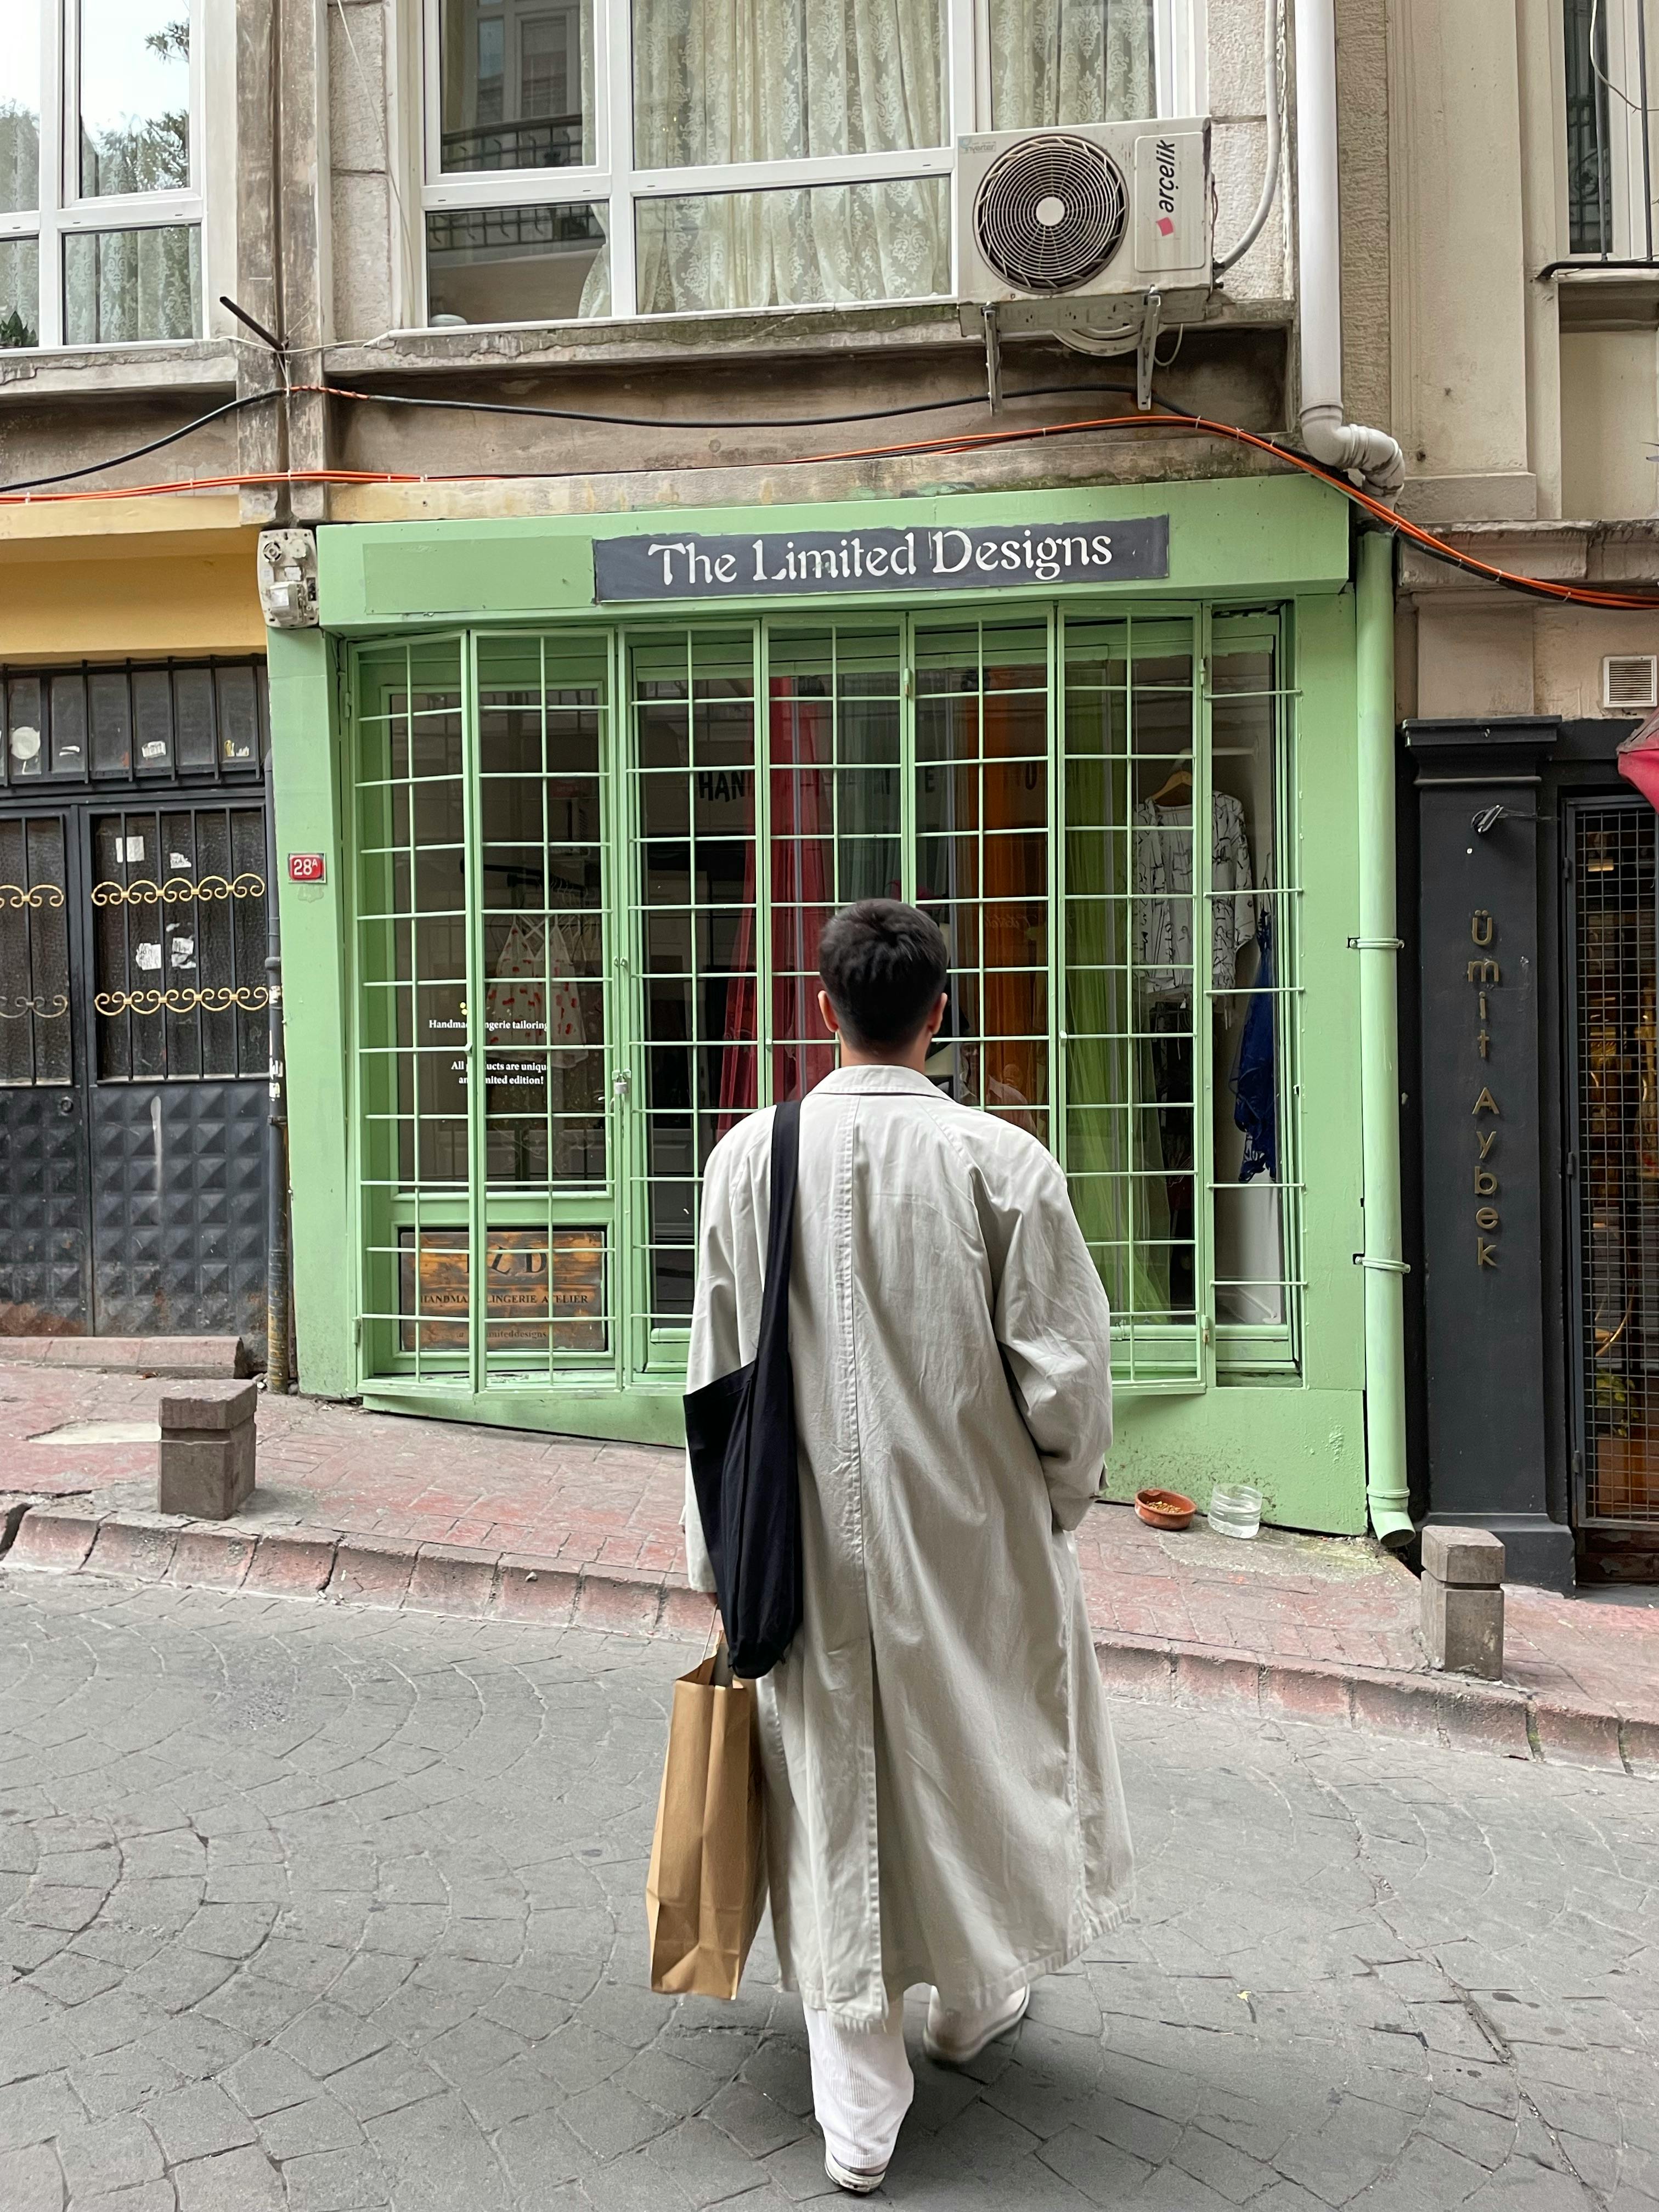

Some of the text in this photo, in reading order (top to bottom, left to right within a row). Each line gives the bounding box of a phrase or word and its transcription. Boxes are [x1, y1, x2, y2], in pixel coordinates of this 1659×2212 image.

[1156, 139, 1179, 213] arçelik
[647, 528, 1113, 586] The Limited Designs
[429, 1019, 467, 1029] Handma
[451, 1061, 464, 1070] All
[521, 1062, 548, 1073] uniqu
[509, 1075, 544, 1085] edition!
[1471, 1087, 1500, 1267] Aybek
[541, 1295, 588, 1304] AELIER
